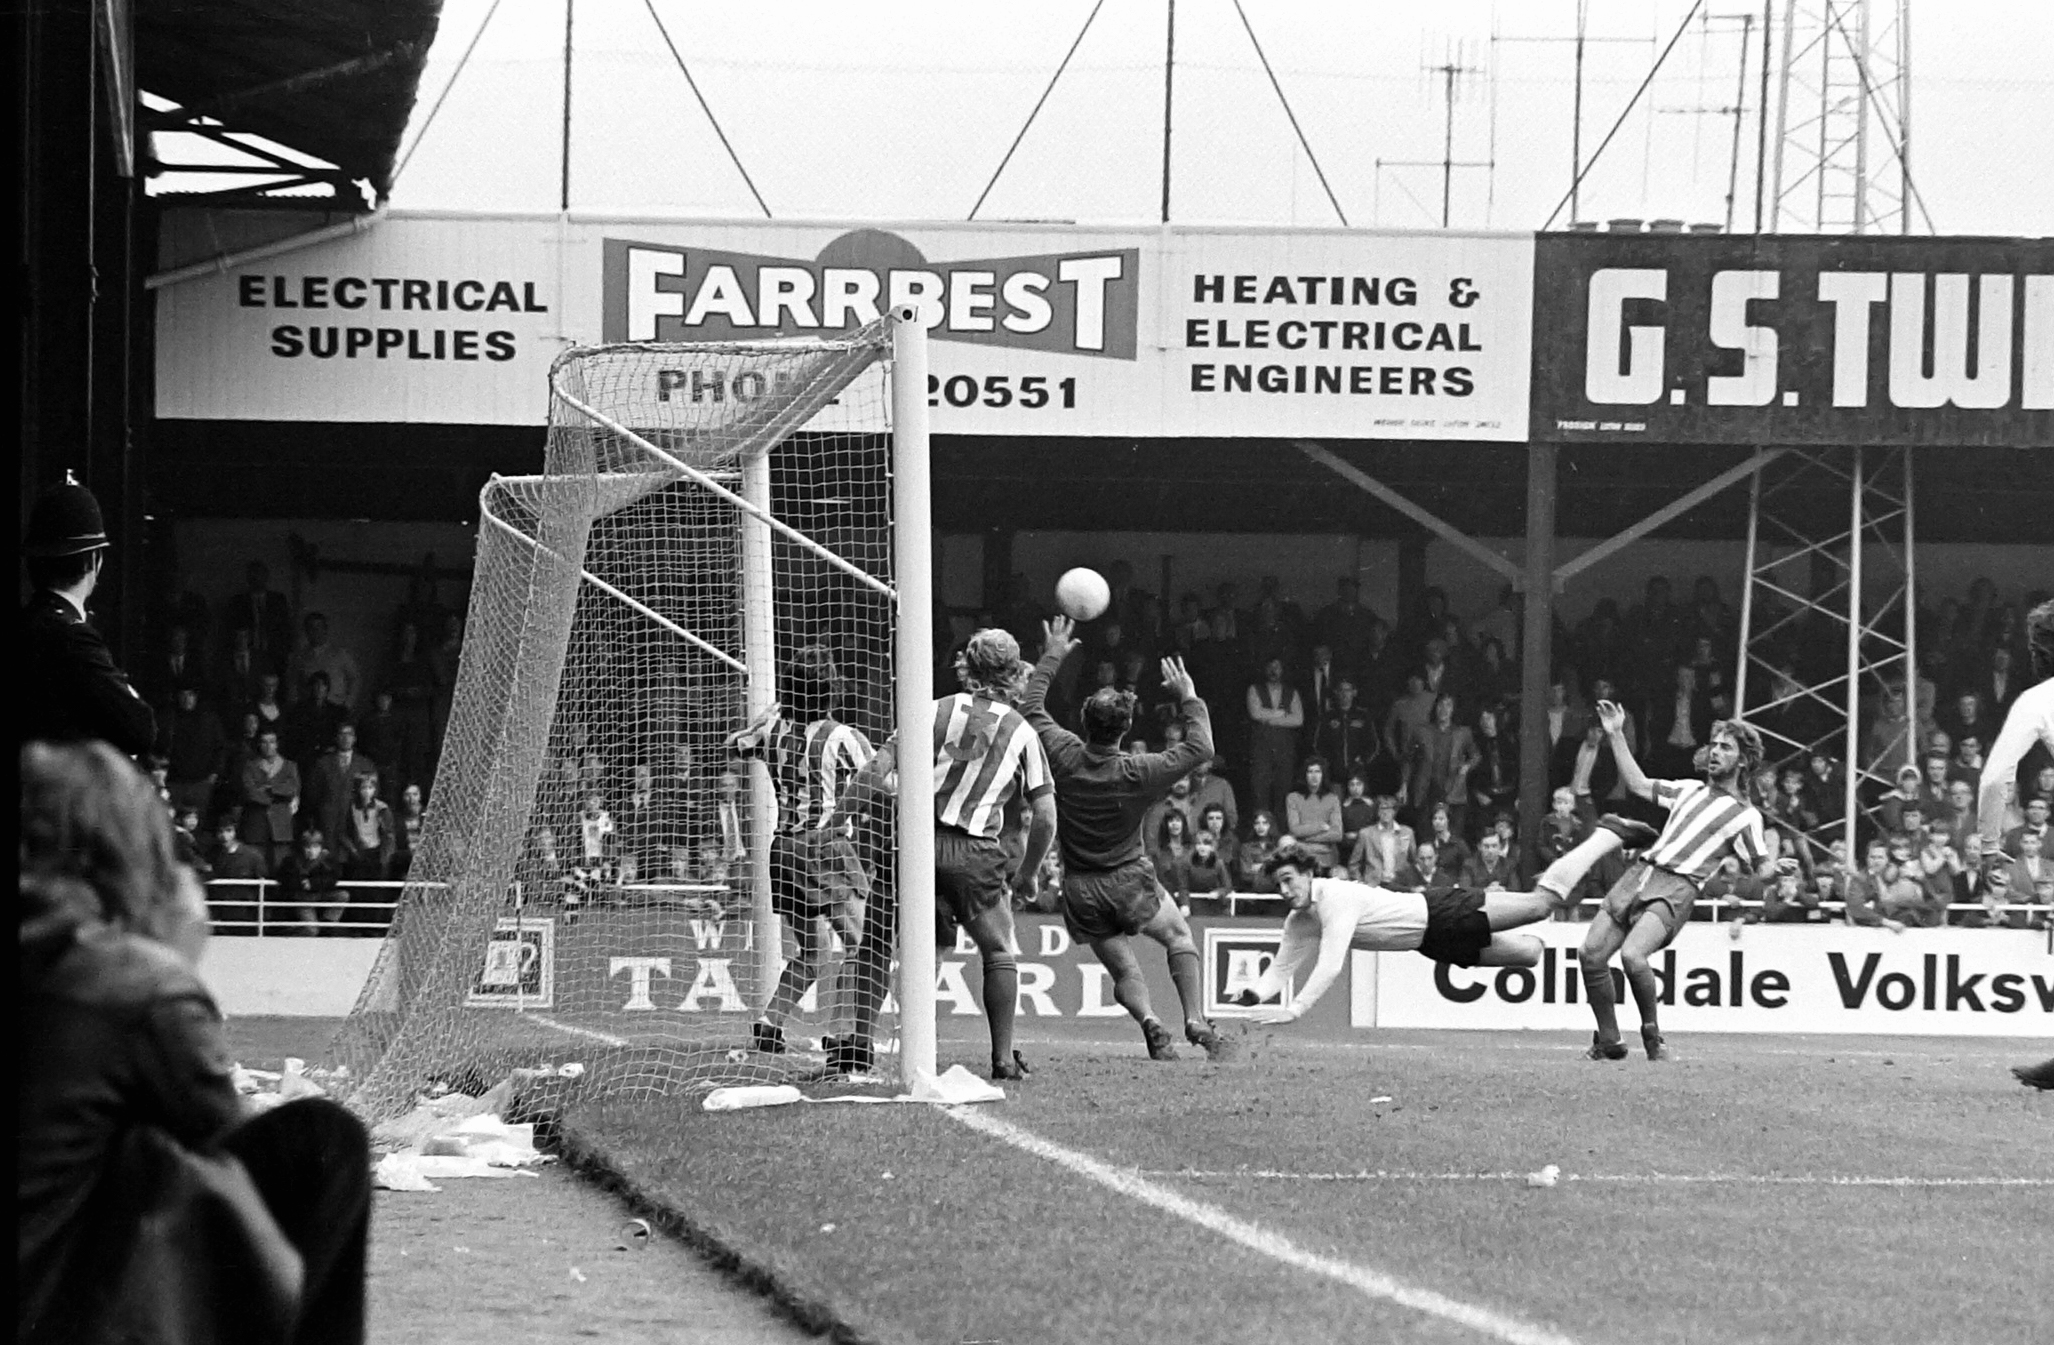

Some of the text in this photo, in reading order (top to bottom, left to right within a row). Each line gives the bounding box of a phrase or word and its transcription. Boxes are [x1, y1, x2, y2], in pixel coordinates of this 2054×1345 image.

[238, 275, 548, 314] ELECTRICAL
[627, 246, 1124, 351] FARRBEST
[1193, 274, 1480, 309] HEATING &
[271, 325, 517, 362] SUPPLIES
[1186, 318, 1482, 352] ELECTRICAL
[1191, 363, 1475, 397] ENGINEERS
